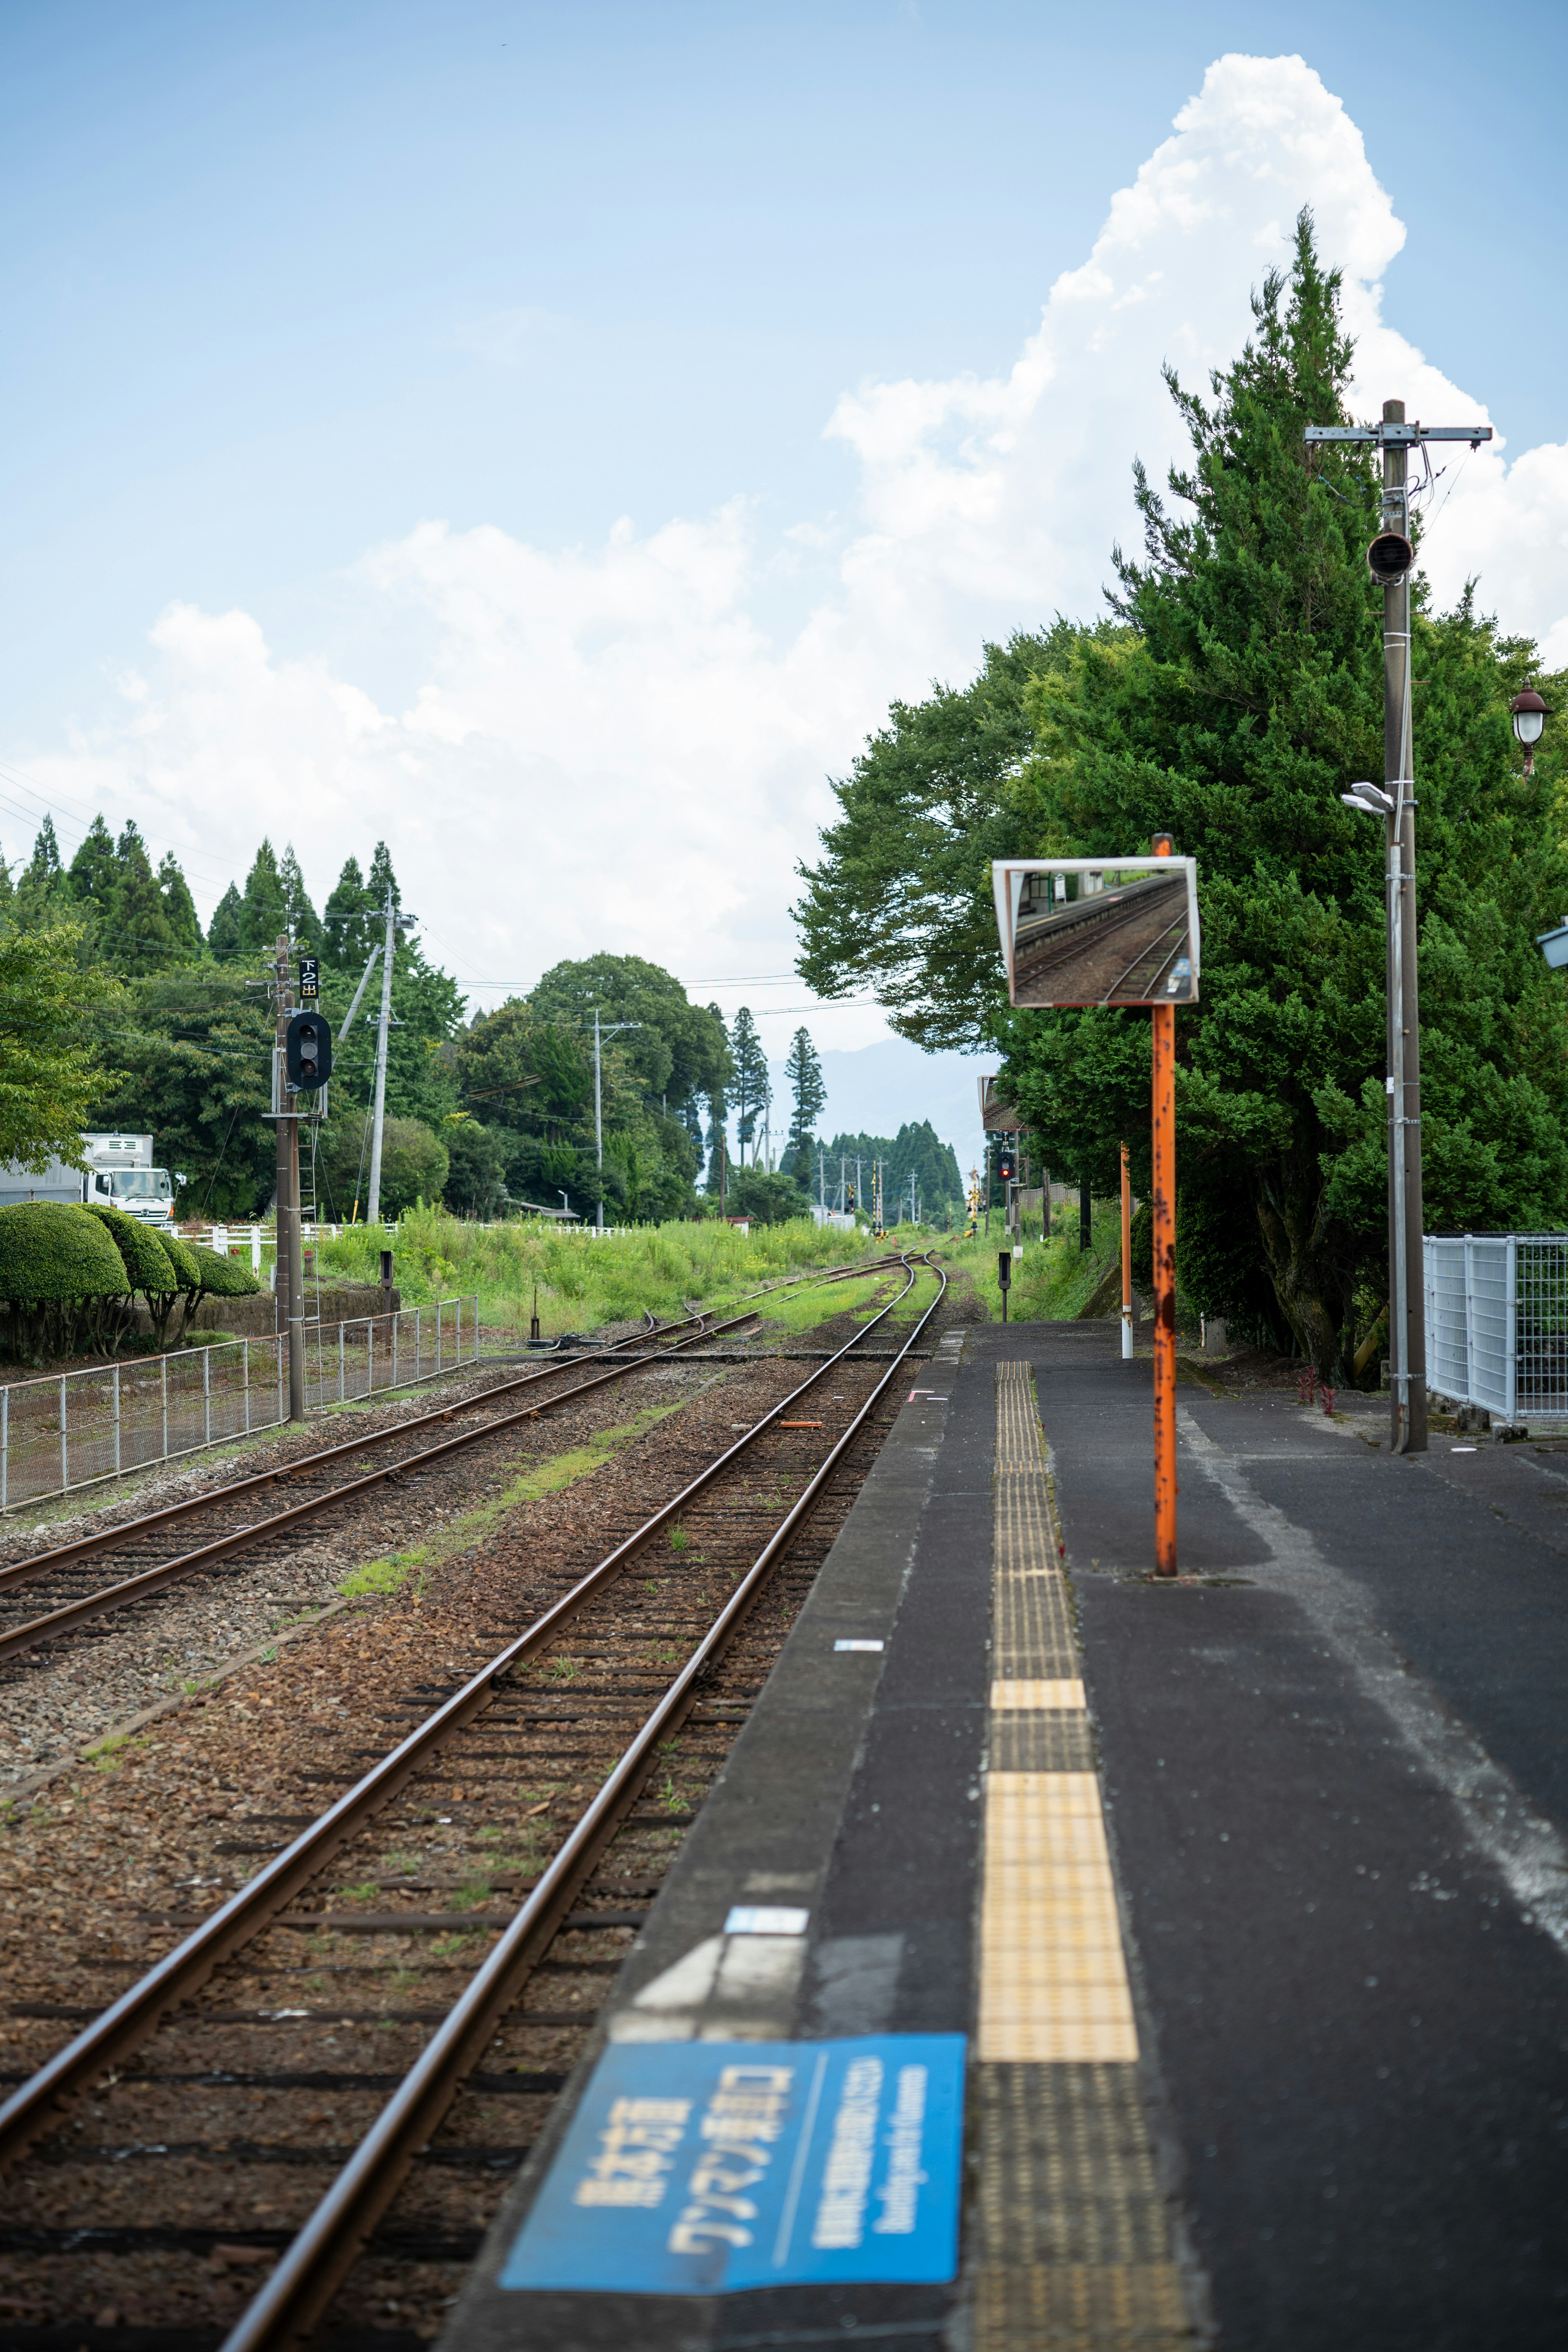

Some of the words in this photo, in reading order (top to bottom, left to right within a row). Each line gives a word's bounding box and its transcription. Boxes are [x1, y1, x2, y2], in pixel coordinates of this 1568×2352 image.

[302, 960, 316, 996] 下2出
[574, 2098, 693, 2208] 熊本方面
[668, 2065, 795, 2254] ワンマン乗車口
[882, 2128, 922, 2146] for
[889, 2148, 920, 2173] area
[873, 2170, 928, 2233] Boarding
